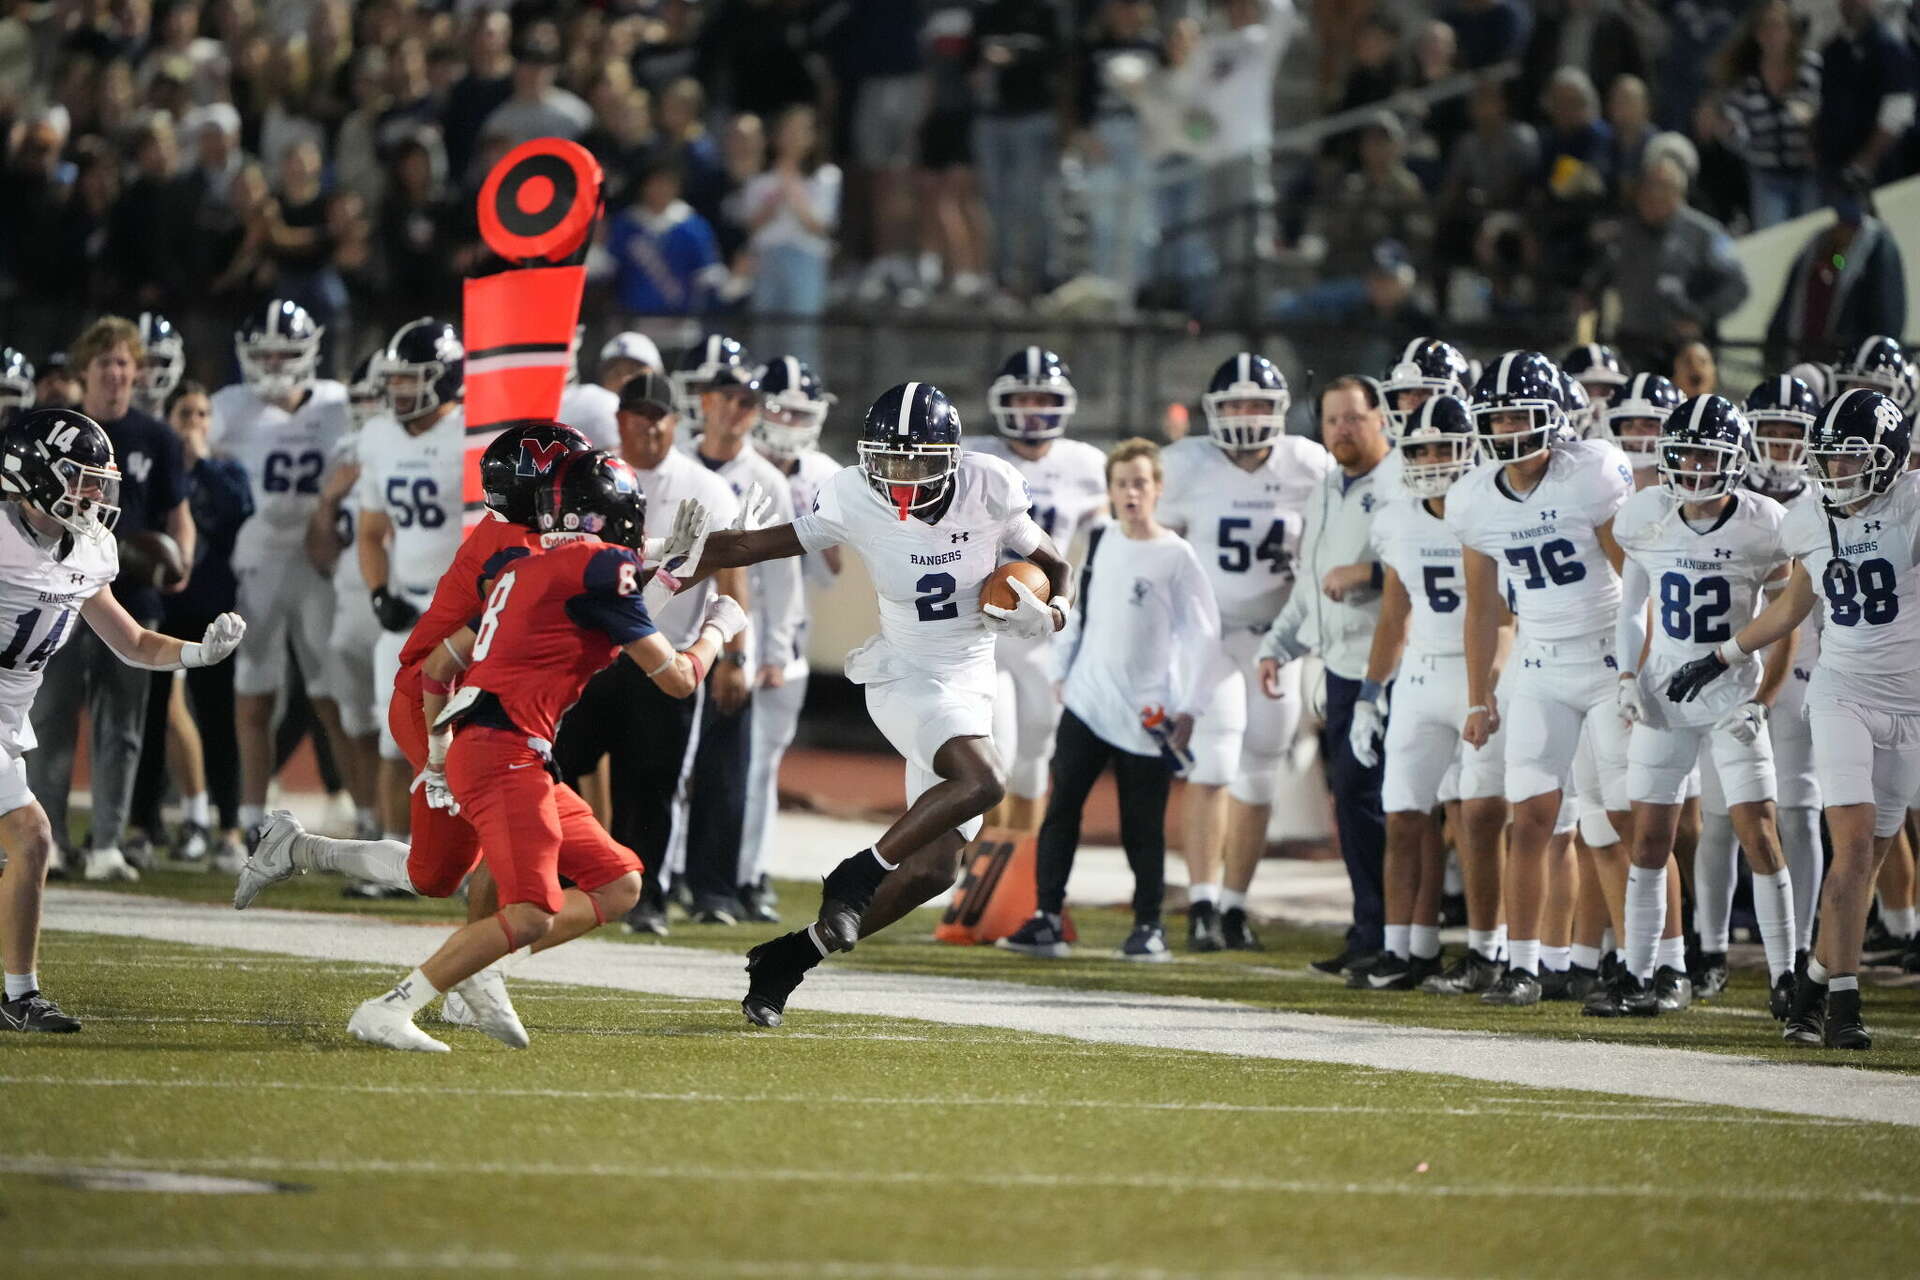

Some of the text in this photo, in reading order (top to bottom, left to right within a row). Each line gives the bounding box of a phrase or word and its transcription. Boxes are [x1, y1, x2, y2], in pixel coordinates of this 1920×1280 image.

[45, 420, 80, 453] 14
[516, 439, 568, 477] M
[264, 452, 323, 492] 62
[387, 477, 446, 528] 56
[1218, 517, 1285, 575] 54
[1511, 524, 1557, 541] RANGERS
[1832, 541, 1878, 558] ANGERS
[617, 563, 638, 596] 8
[910, 550, 962, 566] RANGERS
[1504, 538, 1587, 589] 76
[1676, 558, 1722, 571] RANGERS
[38, 591, 76, 604] RANG
[915, 572, 958, 622] 2
[1423, 566, 1461, 613] 5
[1660, 571, 1731, 643] 82
[1822, 558, 1899, 627] 88
[472, 570, 516, 662] 8
[0, 608, 70, 672] 14
